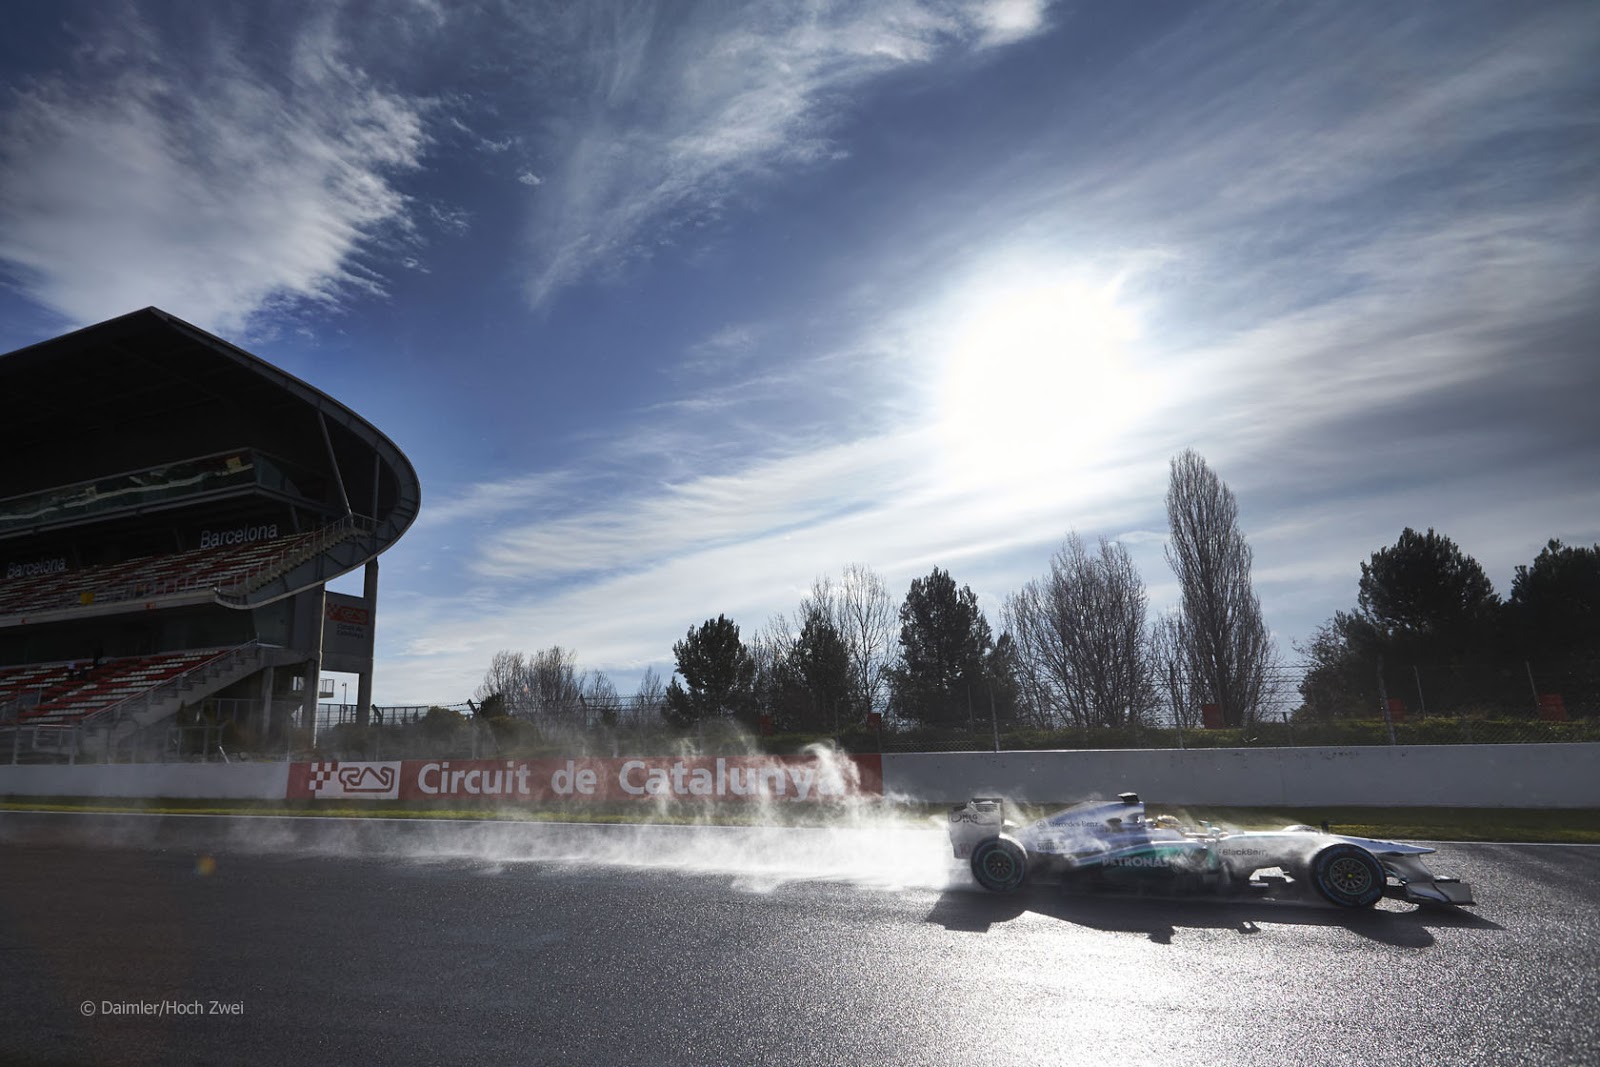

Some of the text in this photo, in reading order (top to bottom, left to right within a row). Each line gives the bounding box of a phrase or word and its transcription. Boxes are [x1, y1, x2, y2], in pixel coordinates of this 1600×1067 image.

[199, 522, 279, 550] Barcelona
[6, 556, 67, 579] Barcelona
[417, 760, 530, 795] Circuit
[551, 760, 597, 795] de
[1102, 857, 1170, 868] PETRONAS
